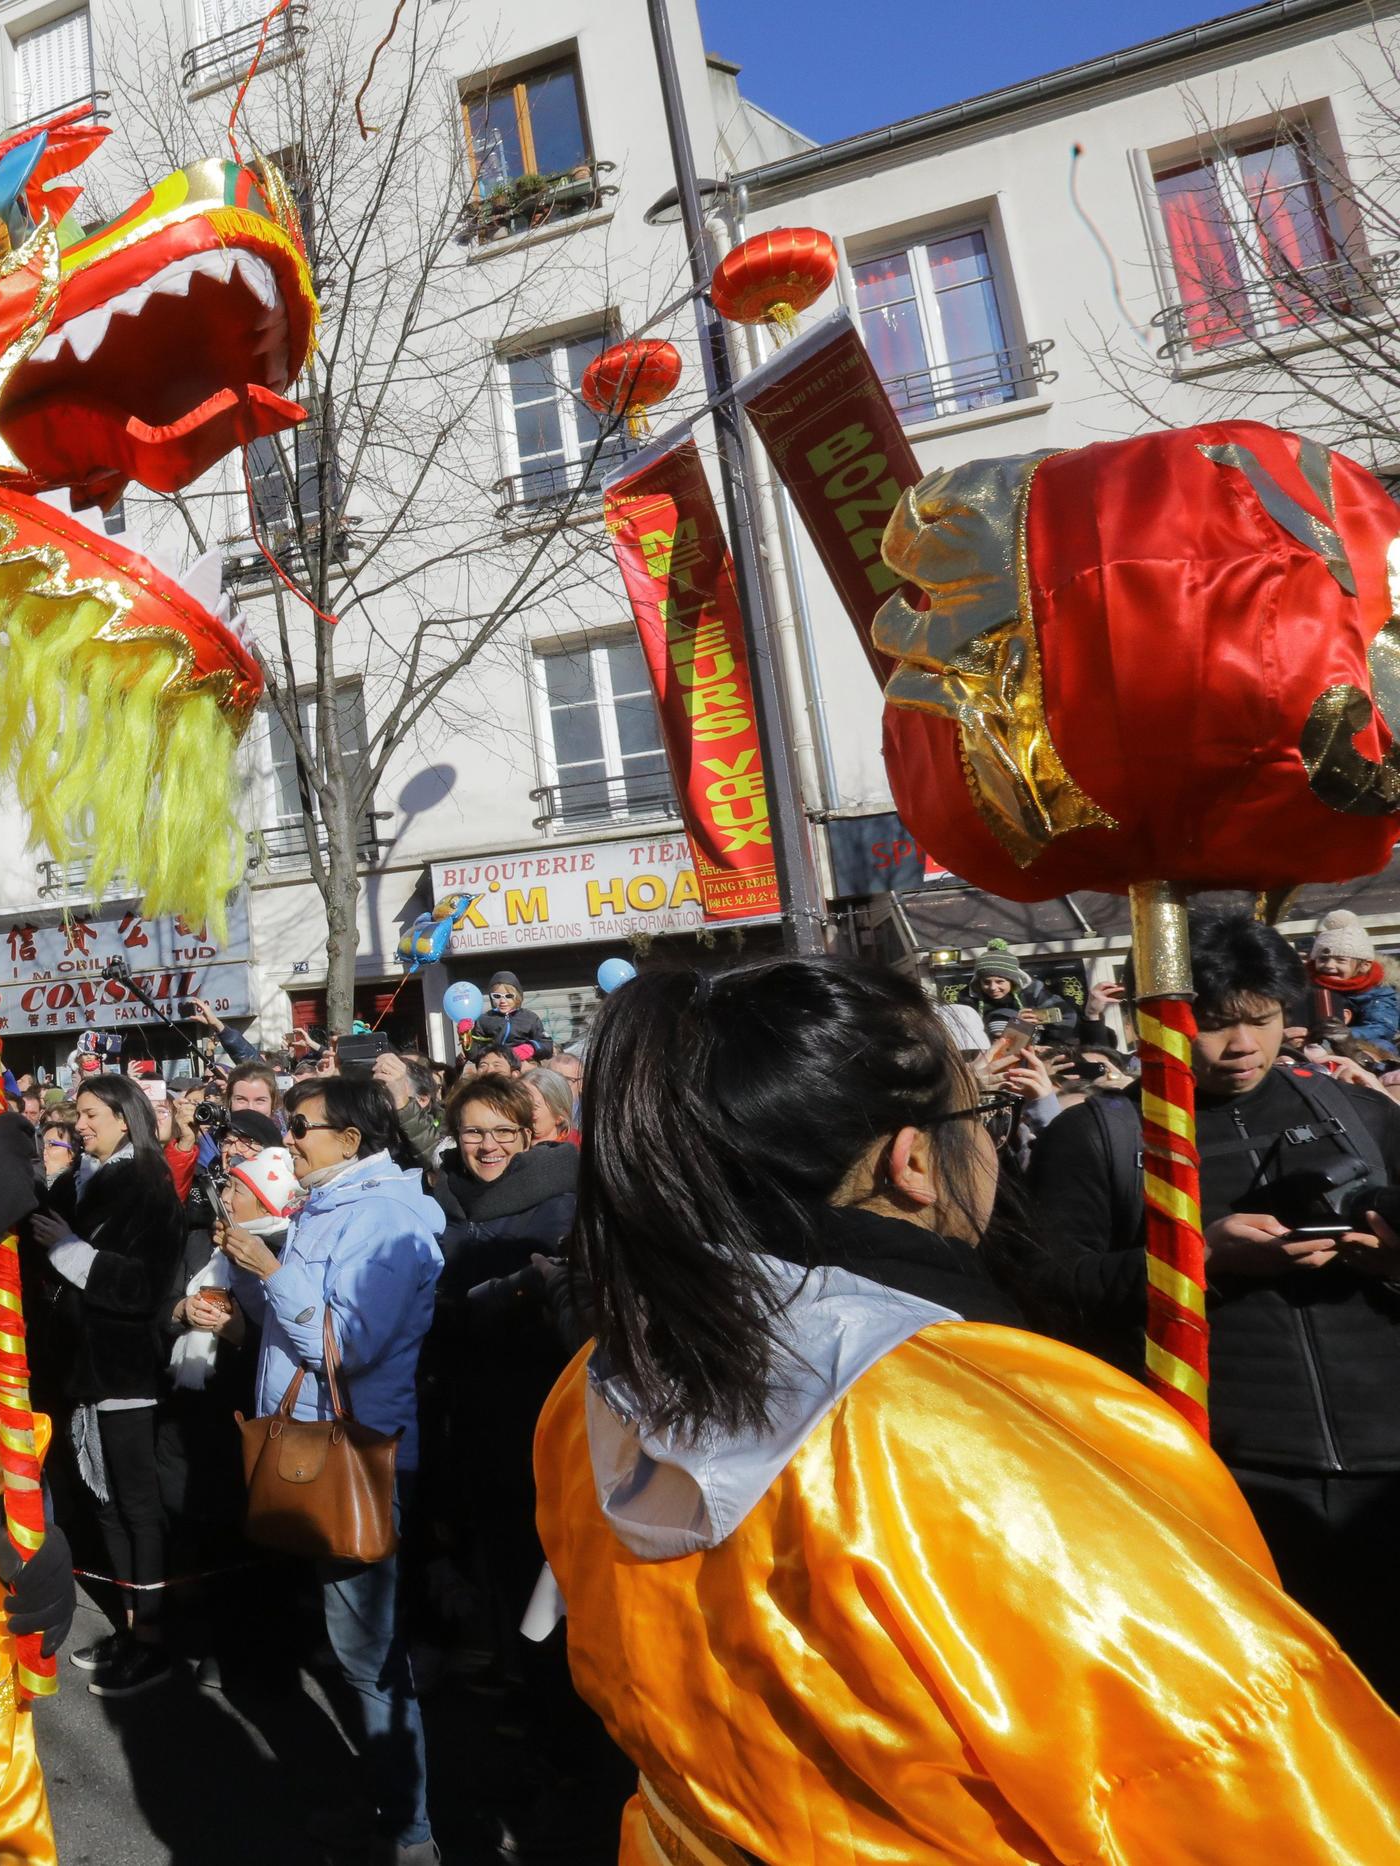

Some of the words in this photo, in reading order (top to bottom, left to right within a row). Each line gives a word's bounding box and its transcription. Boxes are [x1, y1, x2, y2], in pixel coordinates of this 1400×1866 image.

[639, 517, 751, 742] MEILLEURS
[443, 853, 595, 887] BIJOUTERIE
[707, 881, 736, 894] TANG
[514, 923, 582, 943] CREATIONS
[21, 971, 202, 1013] CONSEIL
[115, 1006, 138, 1020] FAX
[215, 998, 230, 1011] 30
